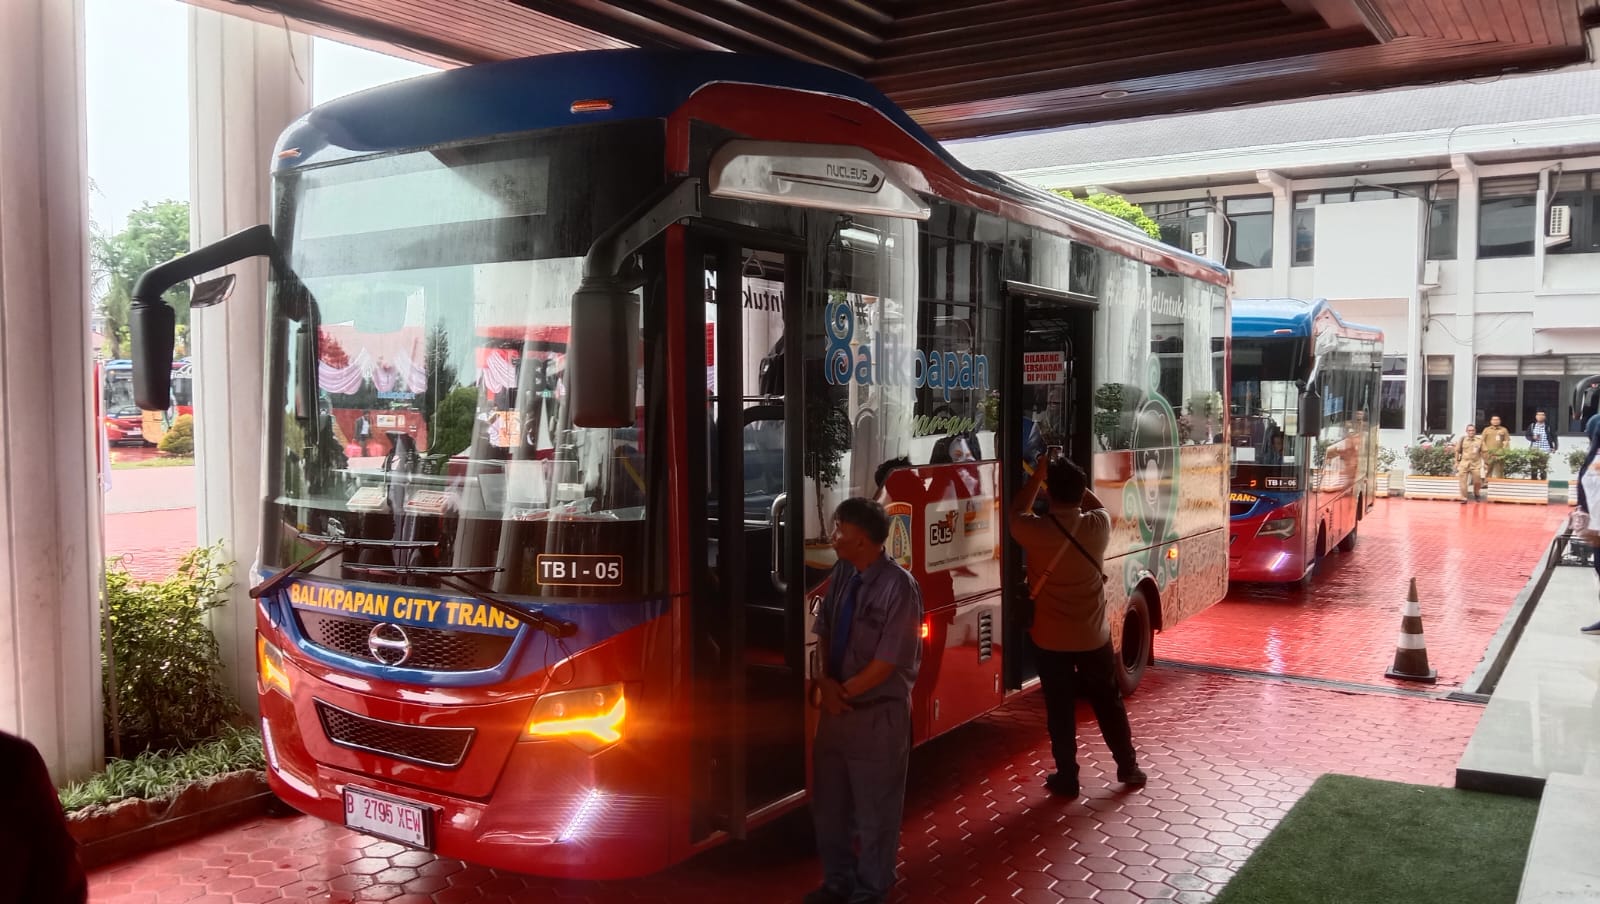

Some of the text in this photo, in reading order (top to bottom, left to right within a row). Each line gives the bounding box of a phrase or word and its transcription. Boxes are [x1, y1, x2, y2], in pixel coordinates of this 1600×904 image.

[826, 164, 868, 180] NUCLEUS
[824, 301, 990, 403] Balikpapan
[1025, 354, 1059, 363] DILARANG
[1036, 373, 1056, 382] PINTU
[1229, 492, 1257, 502] RANS
[540, 561, 566, 578] TB
[595, 562, 619, 579] 05
[291, 582, 519, 630] BALIKPAPAN CITY TRANS
[346, 793, 354, 814] B
[364, 798, 393, 825] 2795
